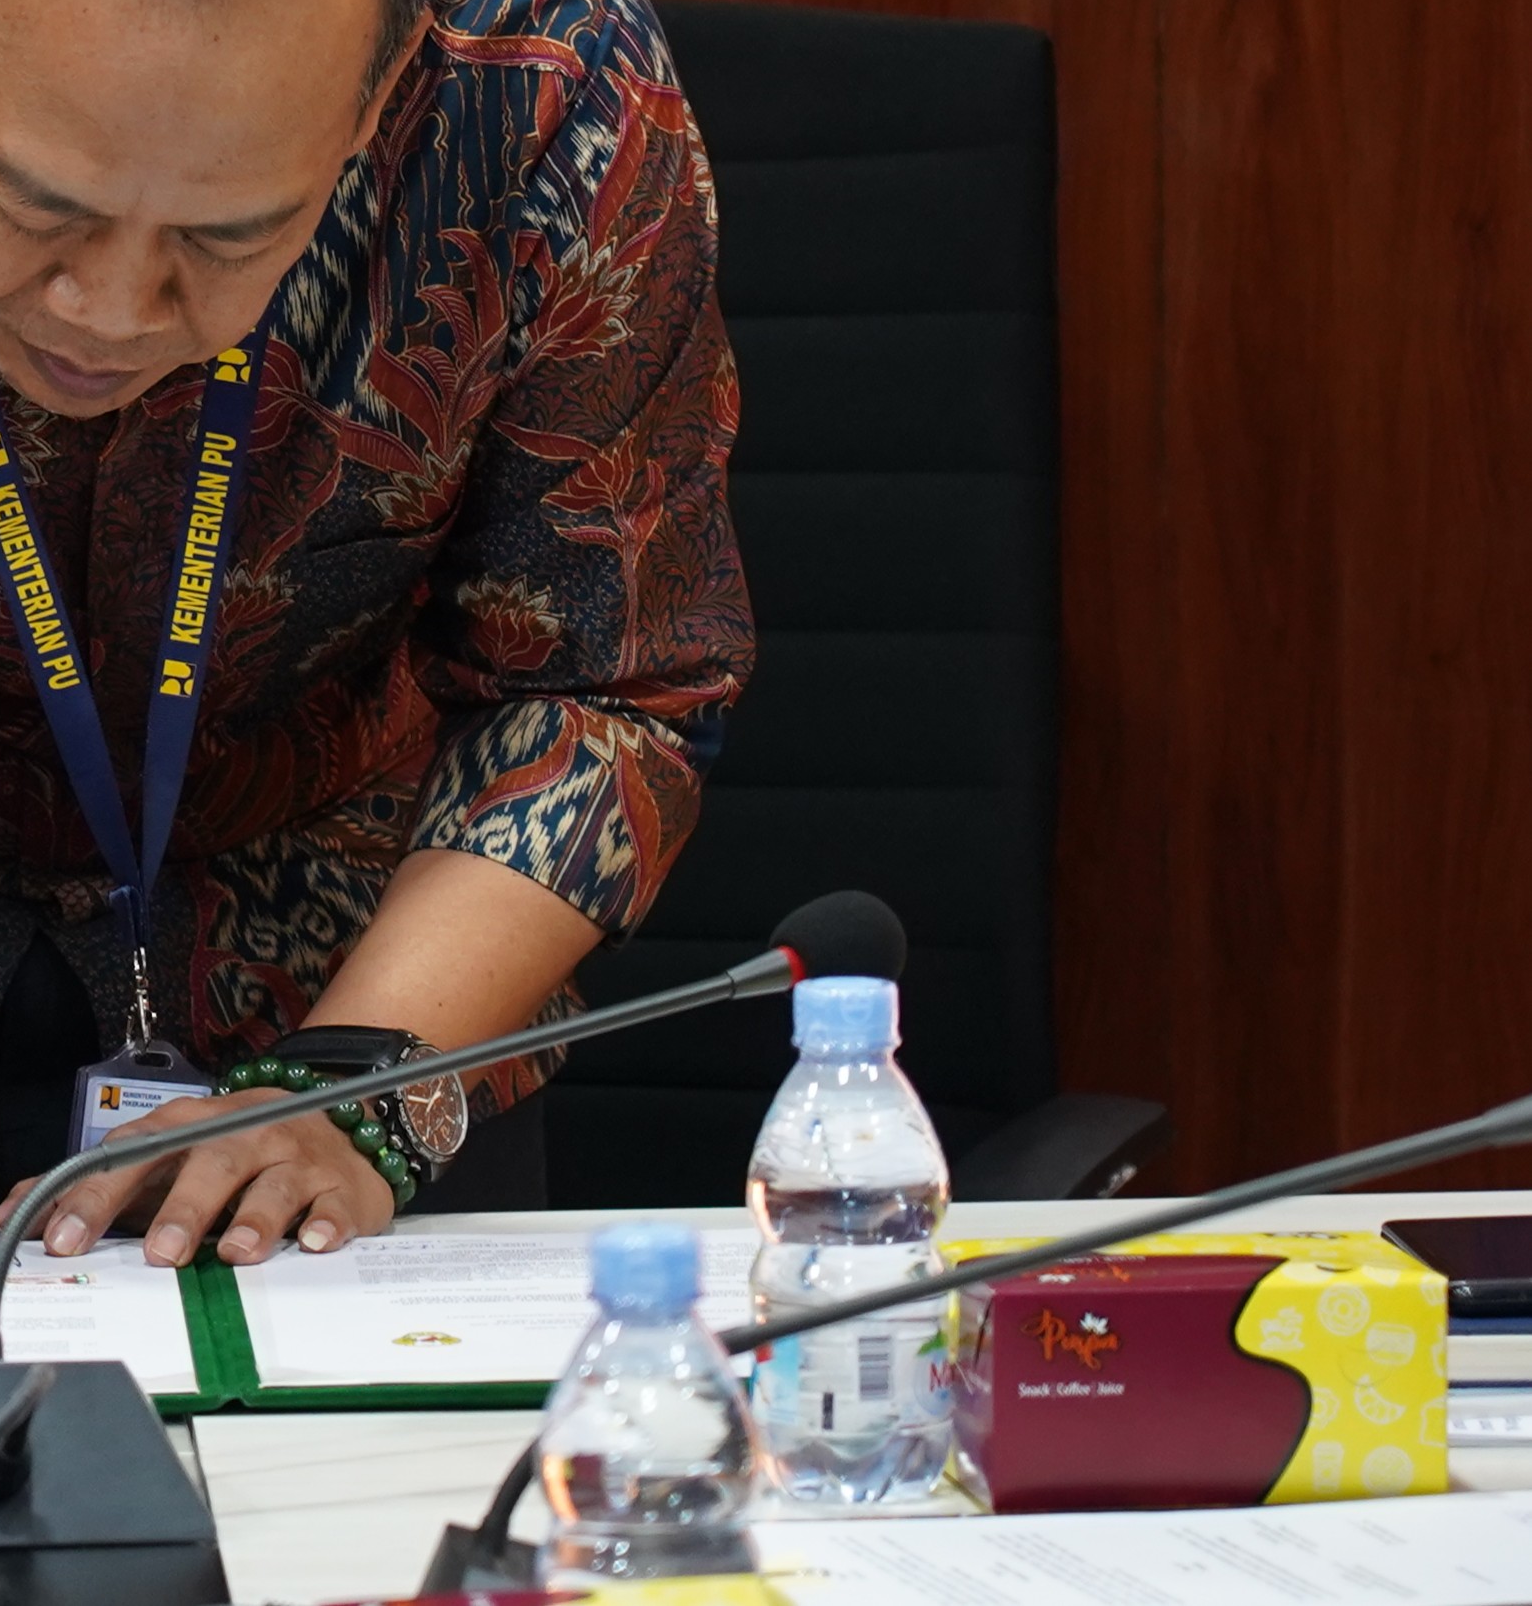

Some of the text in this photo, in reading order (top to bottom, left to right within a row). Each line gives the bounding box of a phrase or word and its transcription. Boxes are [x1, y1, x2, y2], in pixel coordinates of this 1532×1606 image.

[170, 432, 239, 646] KEMENTERIAN PU
[41, 654, 81, 692] PU
